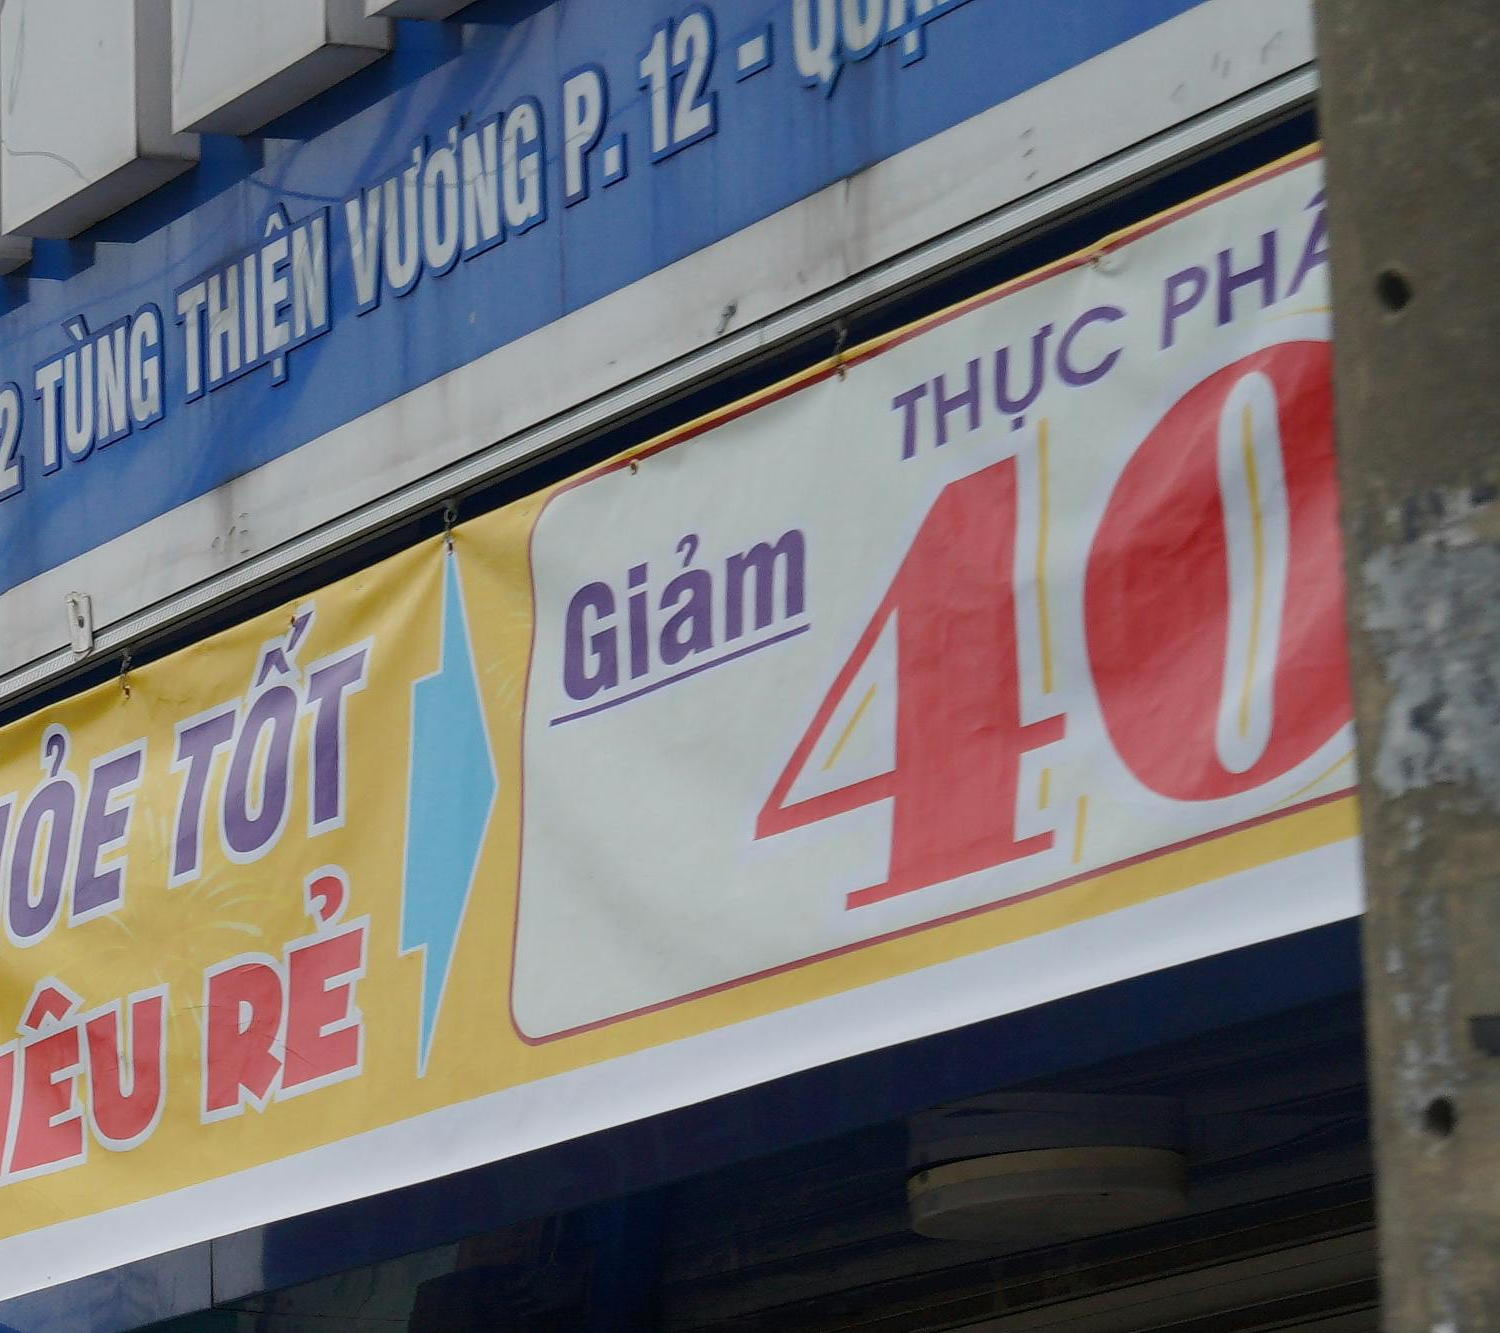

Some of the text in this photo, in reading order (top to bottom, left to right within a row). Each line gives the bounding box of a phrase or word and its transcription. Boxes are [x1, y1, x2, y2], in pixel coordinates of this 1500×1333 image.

[35, 314, 164, 474] TÙNG
[176, 205, 332, 402] THIỆN
[346, 95, 547, 314] VƯƠNG
[562, 64, 626, 202] P.
[640, 8, 718, 164] 12
[892, 306, 1124, 461] THỰC
[561, 533, 807, 702] Giảm
[170, 615, 376, 887] TỐT
[202, 866, 370, 1123] RẺ
